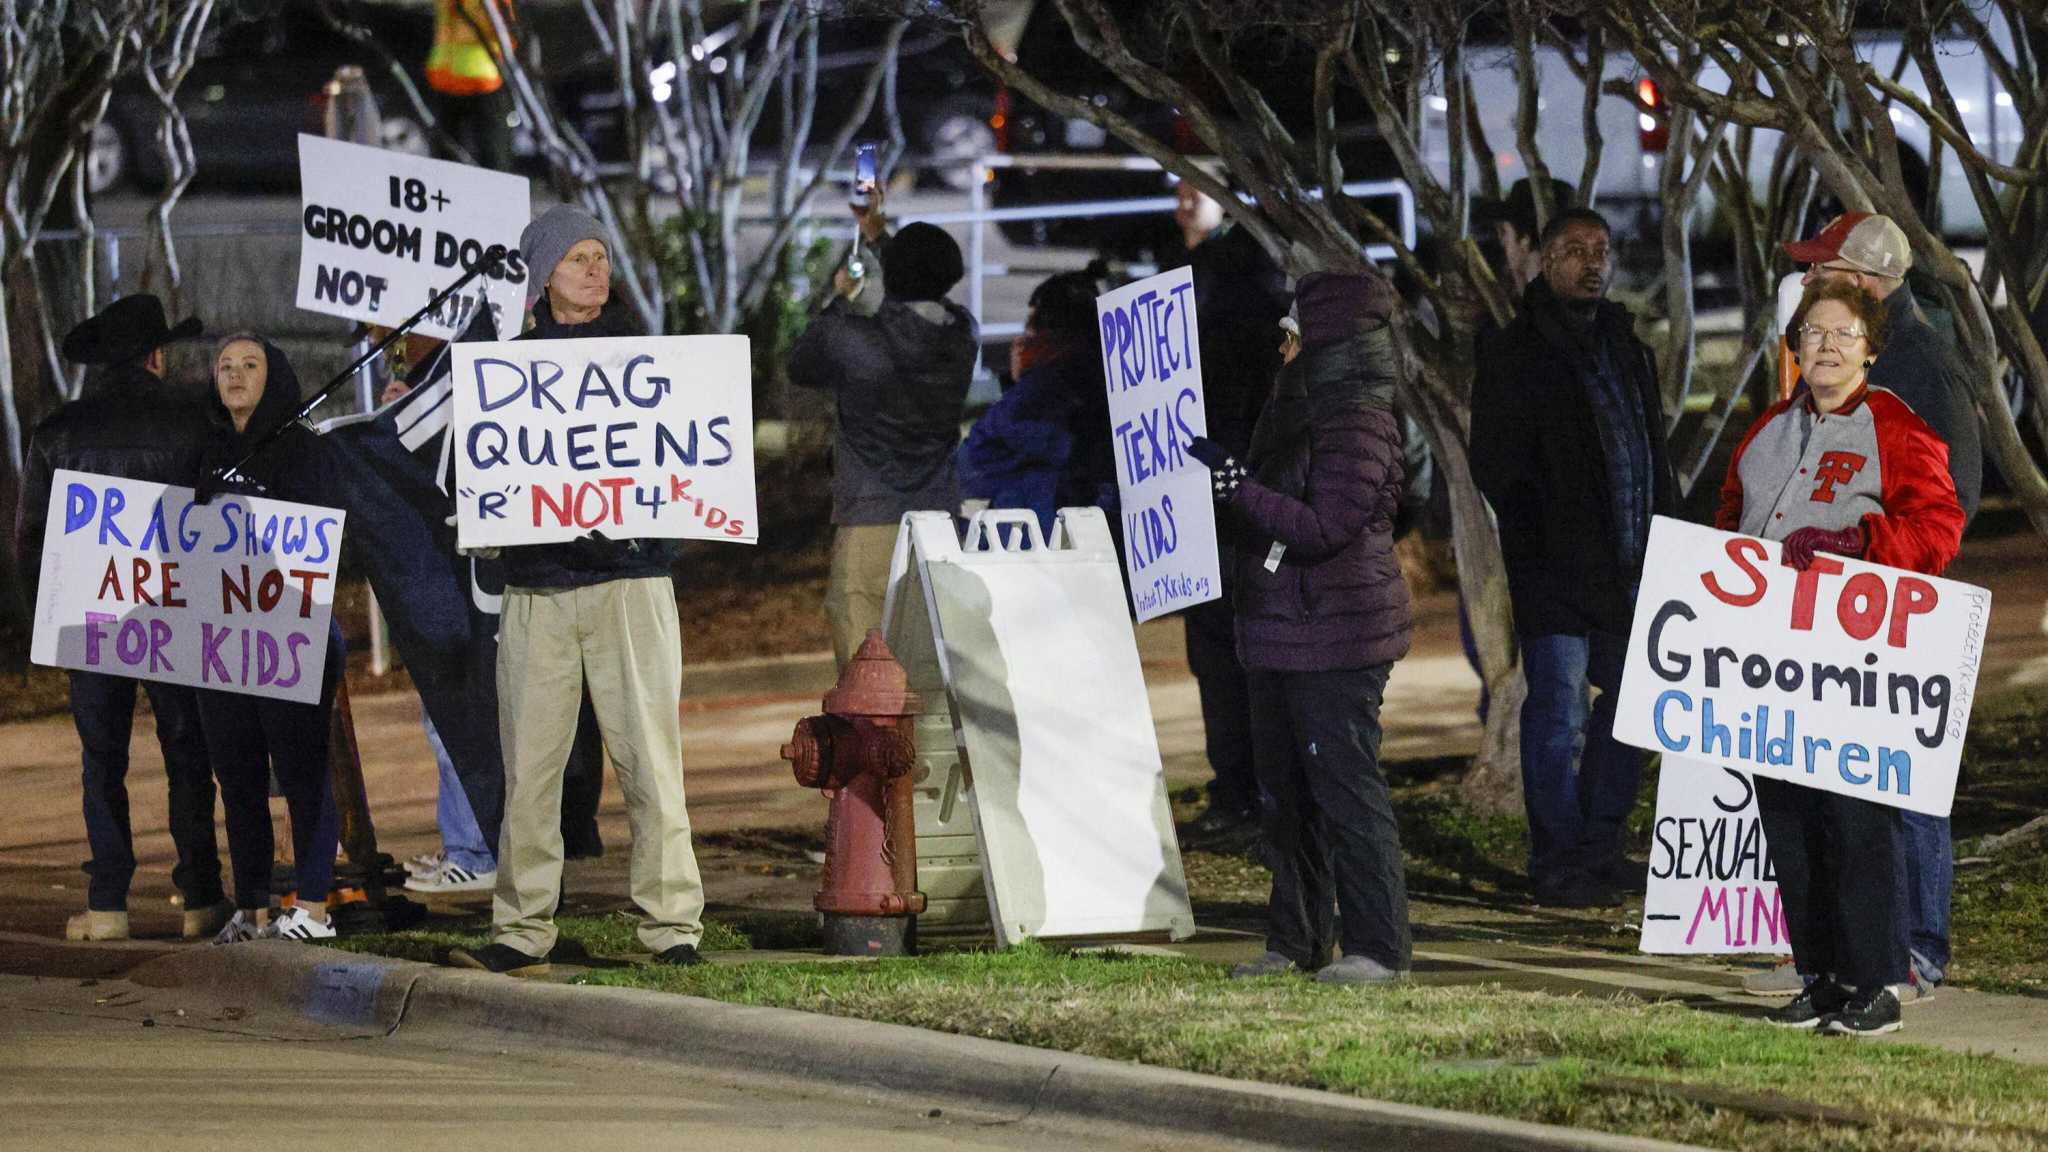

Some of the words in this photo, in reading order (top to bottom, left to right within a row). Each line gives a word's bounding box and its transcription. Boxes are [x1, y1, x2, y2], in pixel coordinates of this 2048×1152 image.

[389, 175, 451, 213] 18+
[303, 204, 422, 262] GROOM
[434, 231, 527, 284] DOGS
[314, 264, 389, 312] NOT
[1102, 282, 1192, 393] PROTECT
[473, 354, 671, 414] DRAG
[466, 416, 733, 471] QUEENS
[1115, 388, 1197, 486] TEXAS
[64, 483, 201, 553] DRAG
[213, 502, 338, 564] SHOWS
[531, 476, 635, 529] NOT
[635, 485, 667, 519] 4
[670, 473, 745, 536] KIDS
[1128, 494, 1177, 572] KIDS
[97, 555, 187, 608] ARE
[221, 564, 330, 618] NOT
[1700, 537, 1939, 648] STOP
[85, 611, 175, 673] FOR
[201, 622, 311, 688] KIDS
[1647, 599, 1951, 749] Grooming
[1653, 689, 1912, 796] Children
